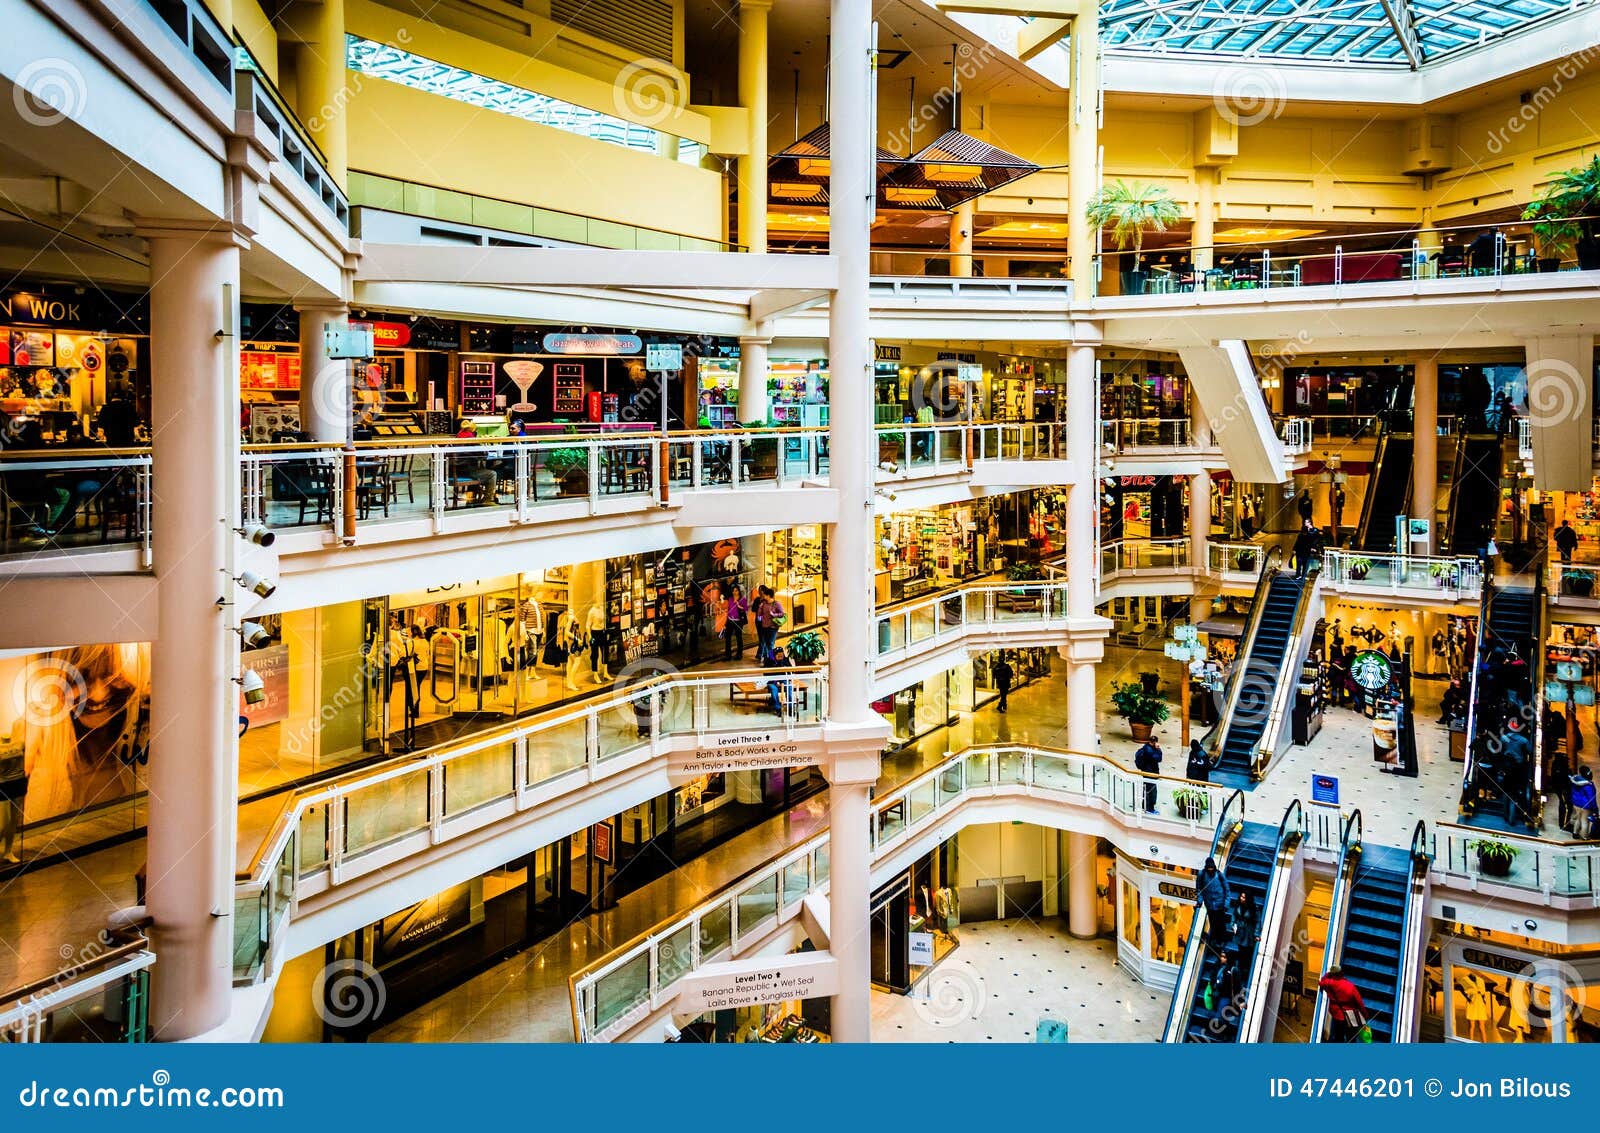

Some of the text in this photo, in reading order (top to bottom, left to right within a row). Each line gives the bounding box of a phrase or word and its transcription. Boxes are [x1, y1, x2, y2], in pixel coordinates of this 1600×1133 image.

[29, 300, 80, 320] WOK
[718, 736, 763, 746] Level Three
[696, 751, 715, 759] Bath
[725, 749, 745, 758] Body
[747, 746, 770, 755] Works
[779, 745, 798, 753] Gap
[683, 755, 813, 772] Ann Taylor The Children's Place
[702, 976, 815, 997] Banana Republic Wet Seal
[735, 973, 773, 984] Level Two
[707, 988, 809, 1008] Laila Rowe Sunglass Hut
